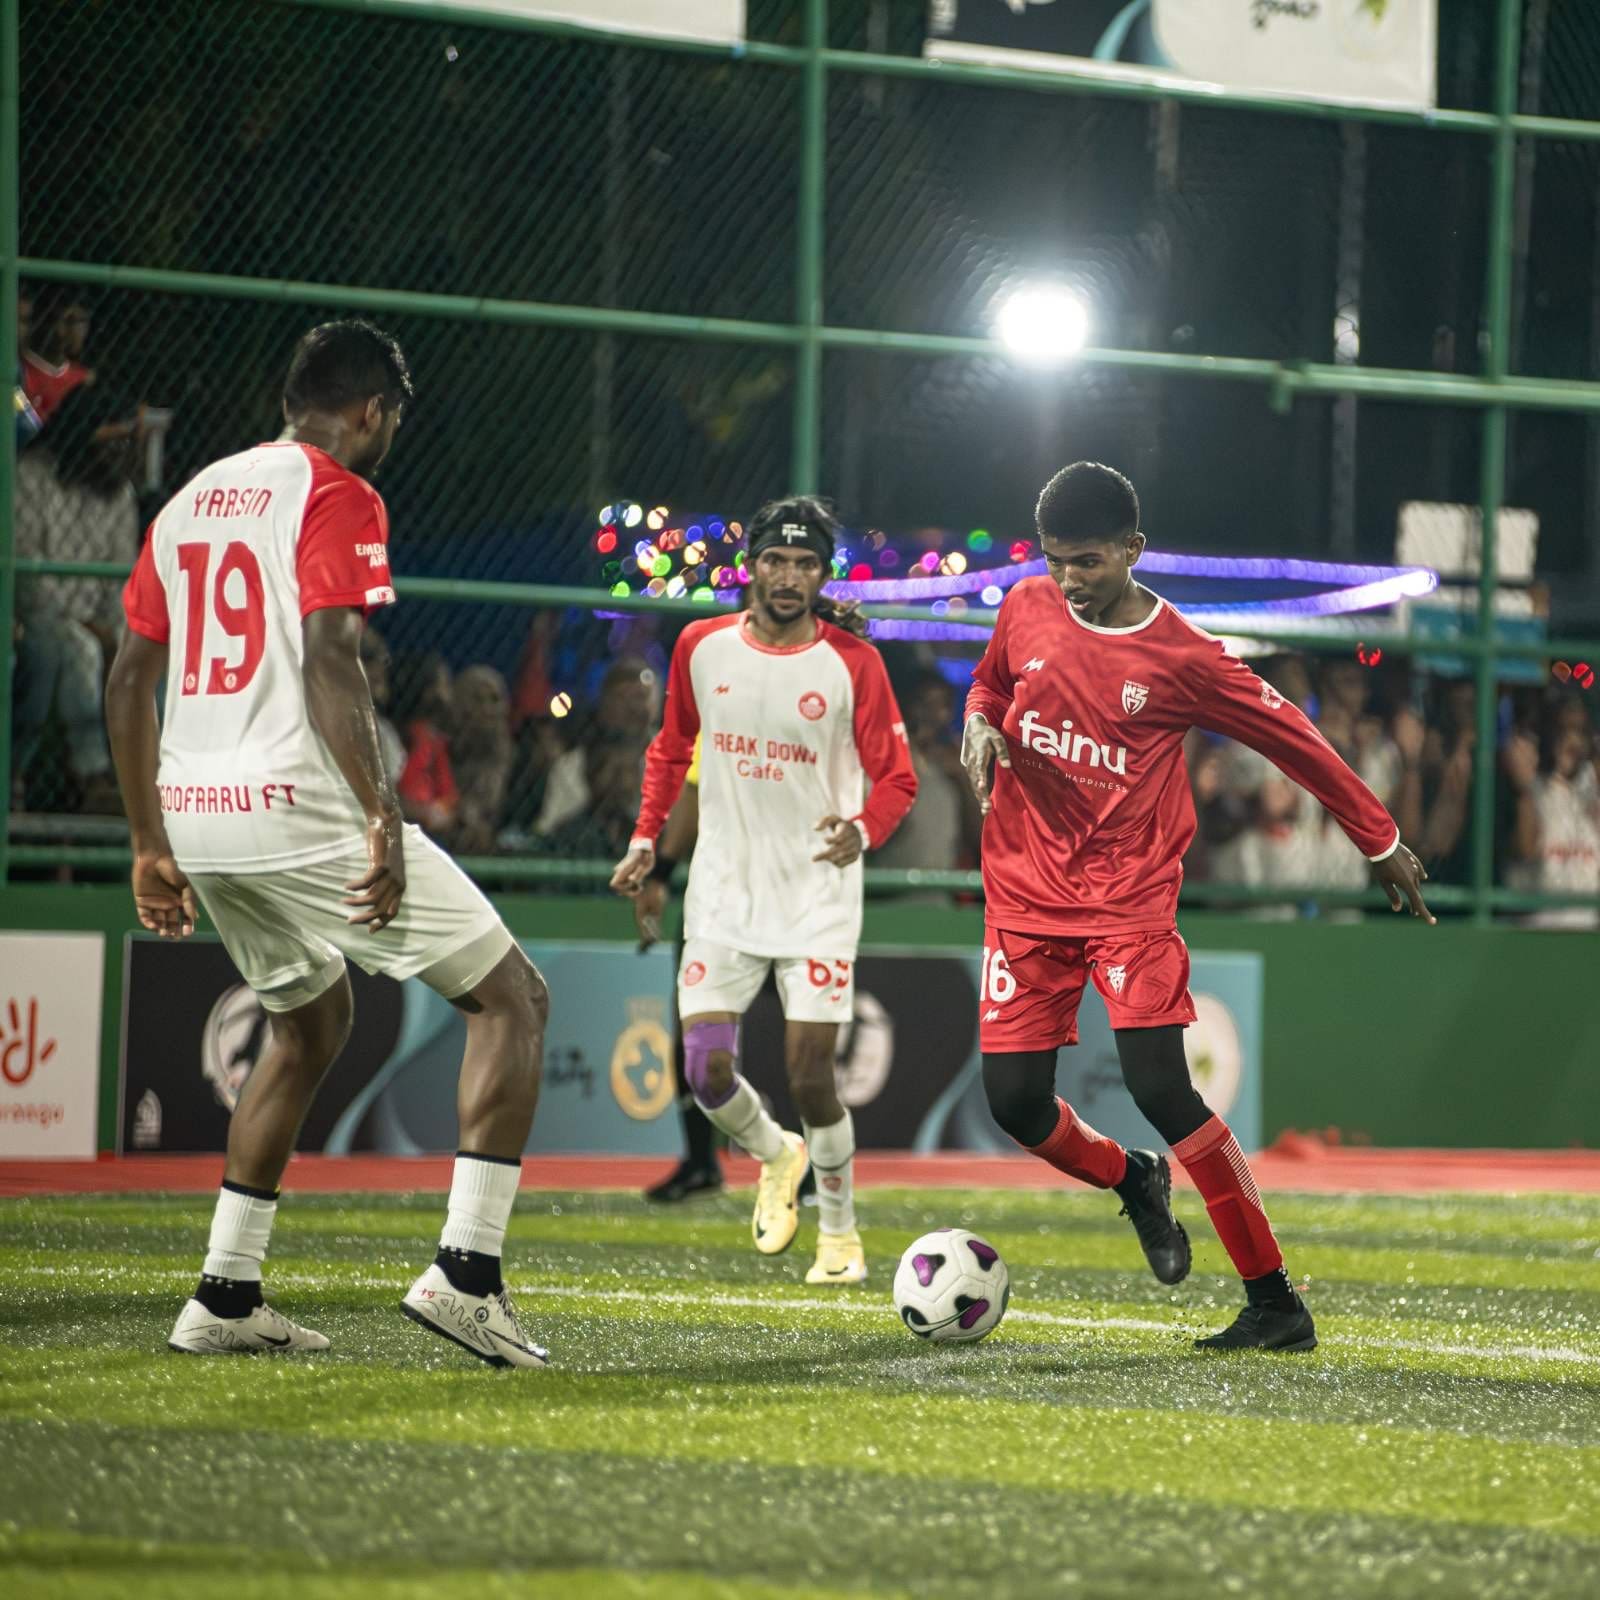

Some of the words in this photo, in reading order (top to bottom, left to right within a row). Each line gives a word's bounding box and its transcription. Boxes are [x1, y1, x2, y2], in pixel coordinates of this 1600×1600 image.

[177, 540, 266, 696] 19
[1018, 710, 1127, 776] fainu
[261, 783, 296, 810] FT
[1065, 773, 1129, 794] HAPPINESS
[980, 946, 1017, 1002] 16
